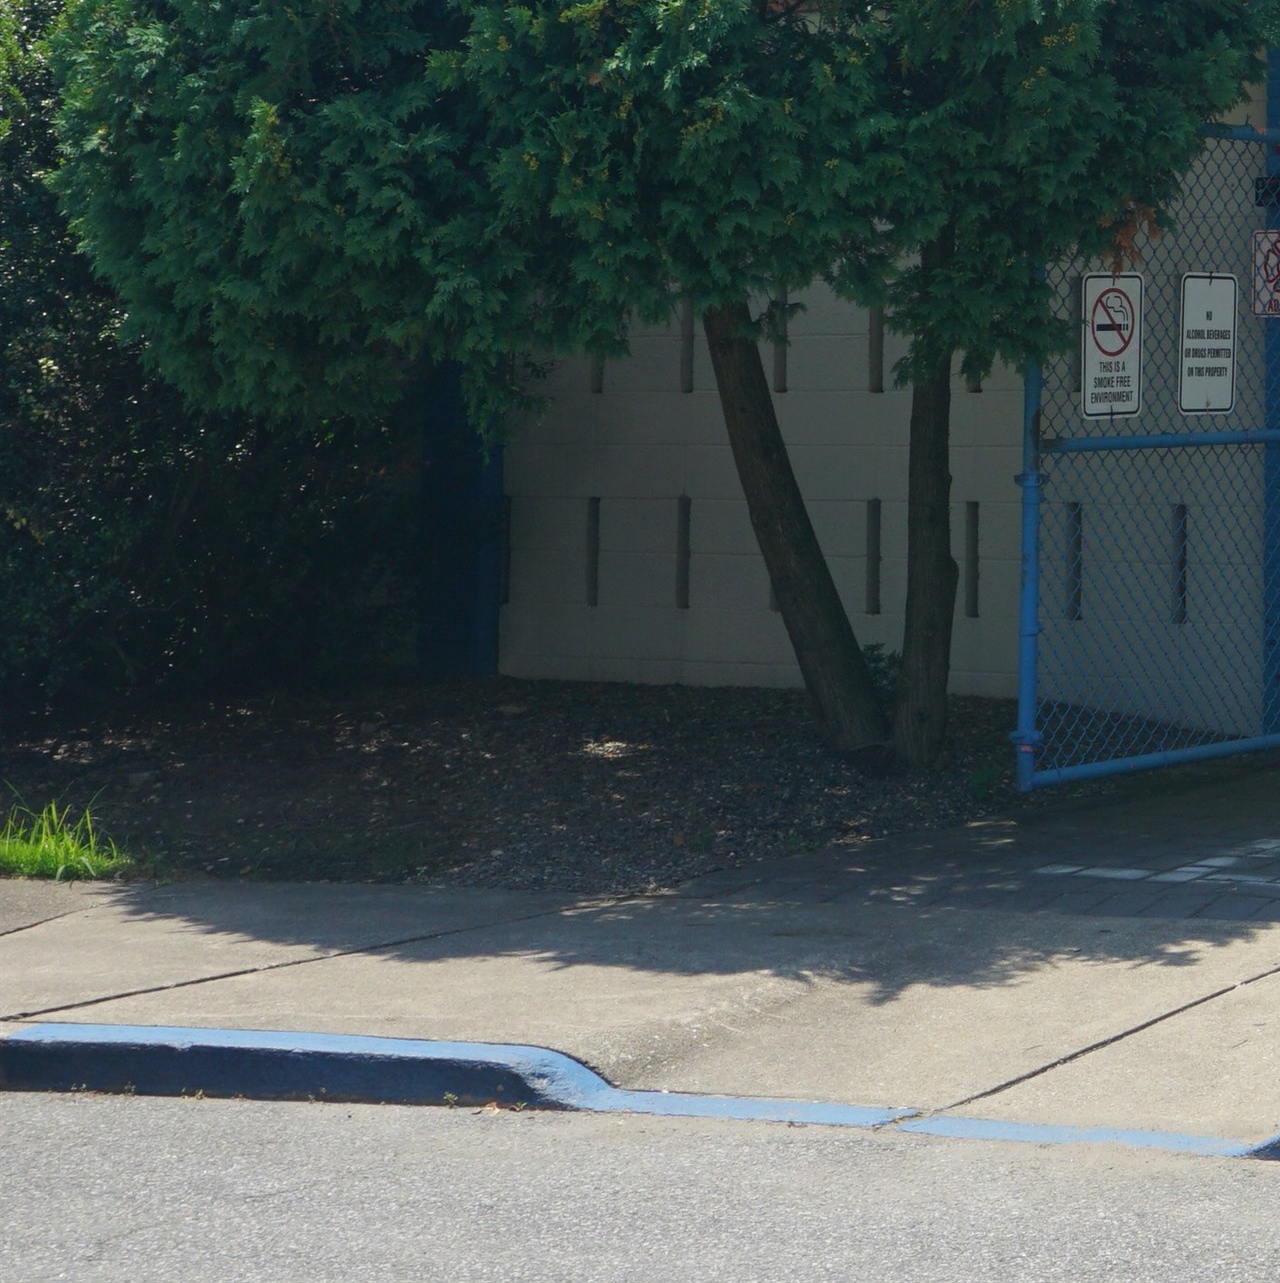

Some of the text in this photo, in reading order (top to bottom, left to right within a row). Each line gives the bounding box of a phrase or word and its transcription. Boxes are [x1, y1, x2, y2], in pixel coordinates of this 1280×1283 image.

[1206, 311, 1213, 321] NO
[1186, 329, 1231, 339] ALCOHOL BEVERAGES
[1192, 348, 1206, 358] DRUGS
[1207, 348, 1231, 358] PERMITTED
[1100, 361, 1126, 373] THIS IS A
[1195, 367, 1204, 377] THIS
[1205, 367, 1228, 377] PROPERTY
[1094, 376, 1131, 388] SMOKE FREE
[1091, 391, 1133, 404] ENVIRONMENT
